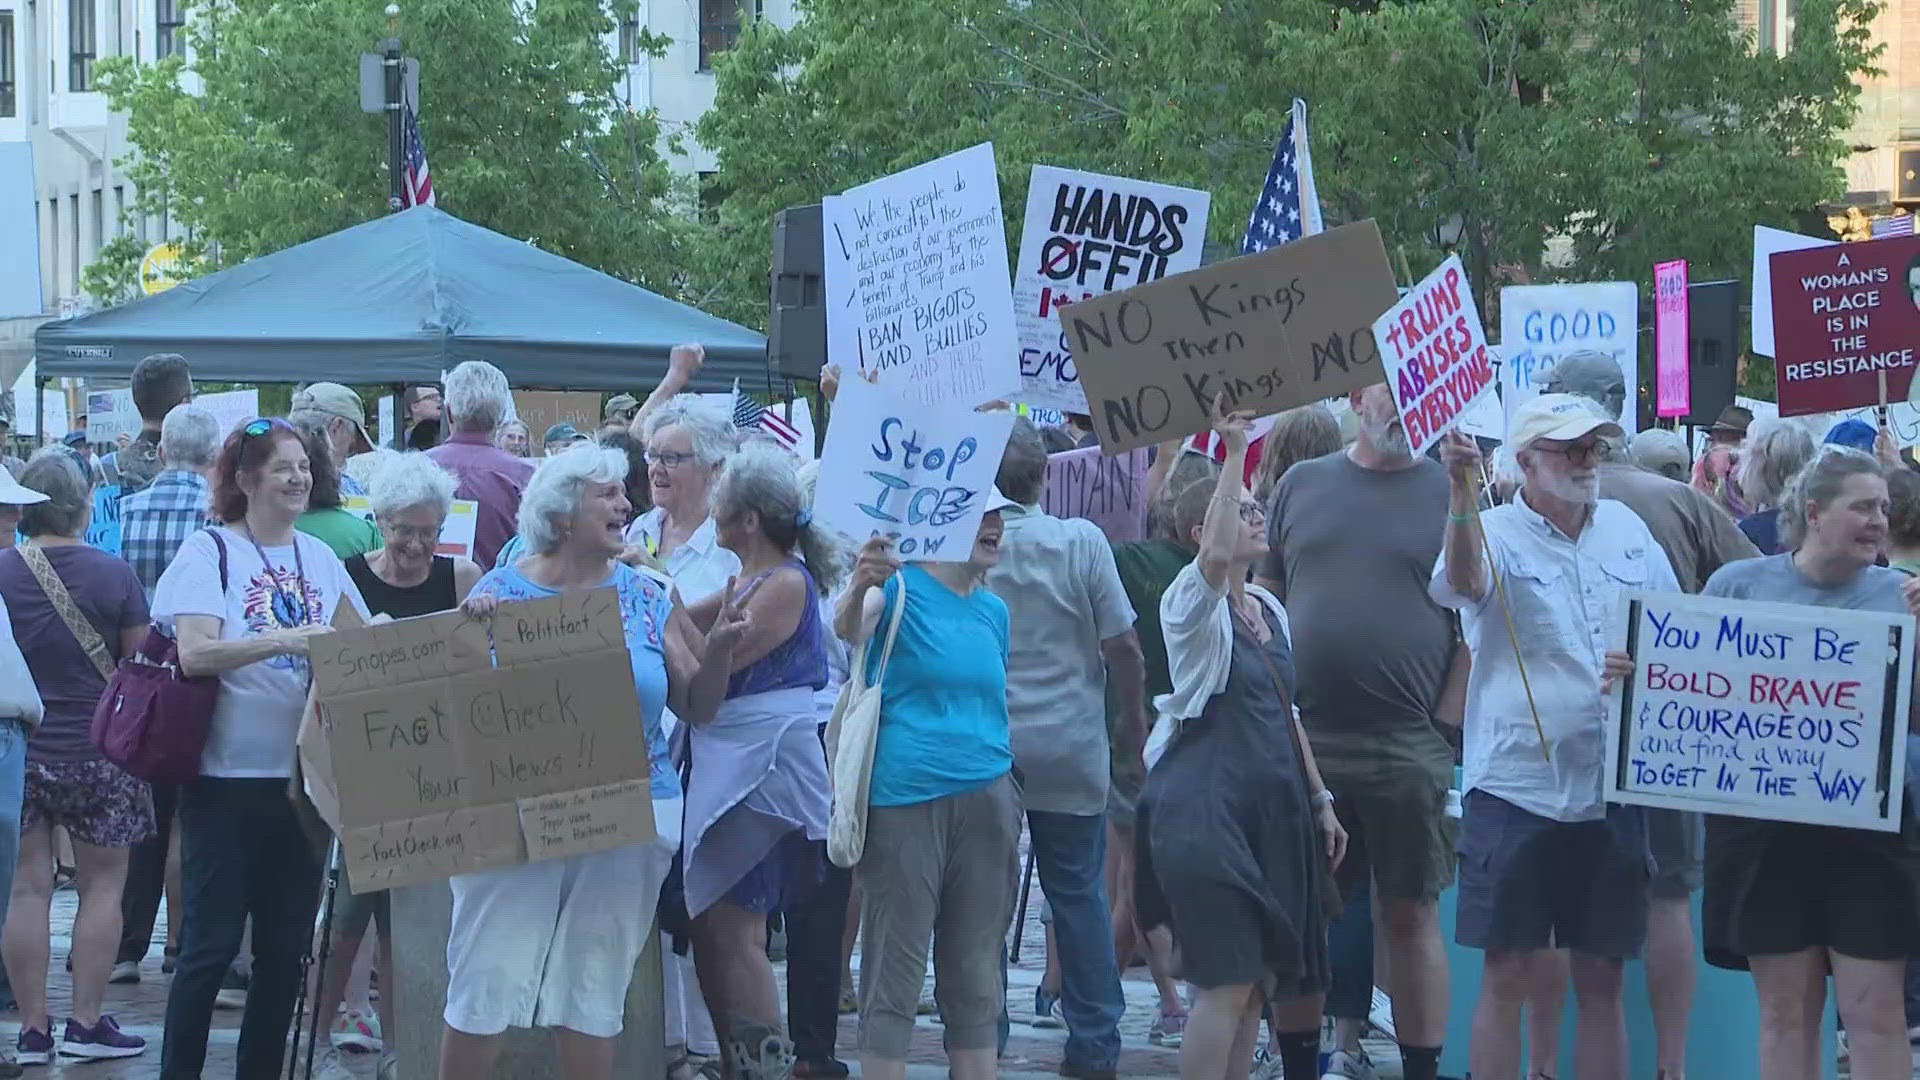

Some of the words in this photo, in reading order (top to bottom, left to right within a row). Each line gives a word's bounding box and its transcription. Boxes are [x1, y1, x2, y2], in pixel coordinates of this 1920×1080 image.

[854, 199, 876, 231] We
[882, 196, 904, 222] the
[910, 180, 944, 228] people
[954, 169, 966, 192] do
[1049, 183, 1189, 256] HANDS
[856, 233, 869, 251] not
[877, 213, 914, 243] consent
[919, 214, 929, 231] to
[940, 204, 962, 224] the
[857, 246, 908, 272] destruction
[913, 233, 923, 259] of
[927, 233, 940, 246] our
[946, 206, 998, 241] government
[858, 270, 875, 289] and
[880, 266, 895, 282] our
[903, 251, 943, 278] economy
[947, 241, 962, 259] for
[969, 233, 990, 251] the
[861, 284, 892, 307] benefit
[900, 277, 910, 301] of
[916, 268, 944, 291] Trump
[950, 255, 966, 275] and
[971, 253, 985, 271] his
[1801, 268, 1889, 291] WOMAN'S
[1837, 252, 1850, 267] A
[868, 313, 903, 350] BAN
[914, 286, 976, 333] BIGOTS
[1073, 298, 1152, 353] NO
[1189, 277, 1305, 327] Kings
[1524, 308, 1616, 344] GOOD
[1812, 291, 1880, 314] PLACE
[1827, 319, 1845, 333] IS
[1850, 315, 1869, 329] IN
[875, 344, 912, 371] AND
[925, 312, 988, 356] BULLIES
[1018, 348, 1078, 382] EMO
[1311, 327, 1378, 383] NO
[1398, 315, 1472, 410] ABUSES
[1785, 349, 1913, 382] RESISTANCE
[1831, 335, 1867, 352] THE
[1102, 384, 1171, 444] NO
[1183, 367, 1284, 418] Kings
[1404, 343, 1493, 450] EVERYONE
[853, 470, 978, 526] ICE
[1045, 448, 1134, 519] UMAN
[338, 639, 446, 677] Snopes.com
[470, 680, 578, 738] Check
[1658, 700, 1862, 748] COURAGEOUS
[1640, 734, 1684, 755] and
[1690, 735, 1745, 765] find
[1755, 750, 1768, 764] a
[1777, 746, 1825, 773] way
[407, 766, 472, 803] Your
[1808, 769, 1867, 805] WAY
